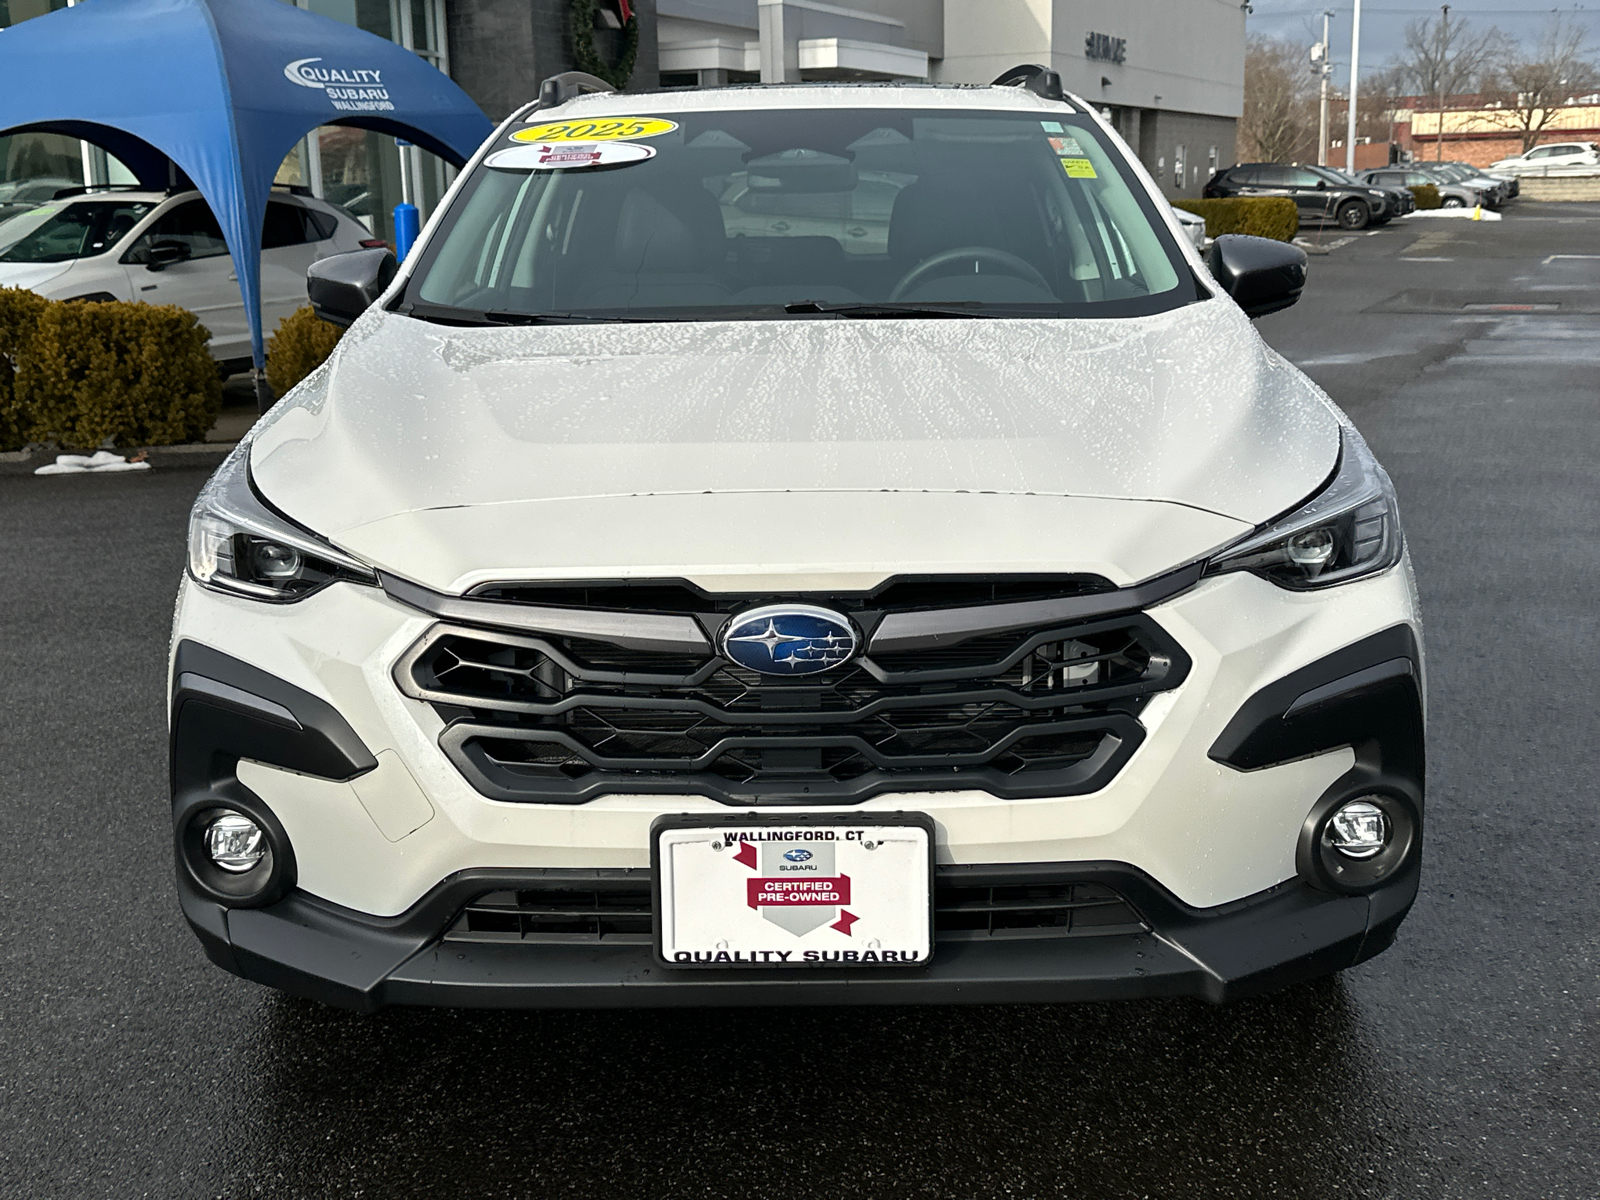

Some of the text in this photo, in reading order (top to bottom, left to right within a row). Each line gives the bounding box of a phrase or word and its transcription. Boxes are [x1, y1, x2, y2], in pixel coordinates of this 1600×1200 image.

[300, 66, 381, 83] QUALITY
[326, 87, 389, 100] SUBARU
[331, 101, 395, 111] WALLINGFORD
[535, 121, 652, 141] 2025
[845, 830, 865, 841] CT
[764, 881, 834, 891] CERTIFIED
[758, 892, 840, 902] PRE-OWNED
[673, 950, 919, 963] QUALITY SUBARU
